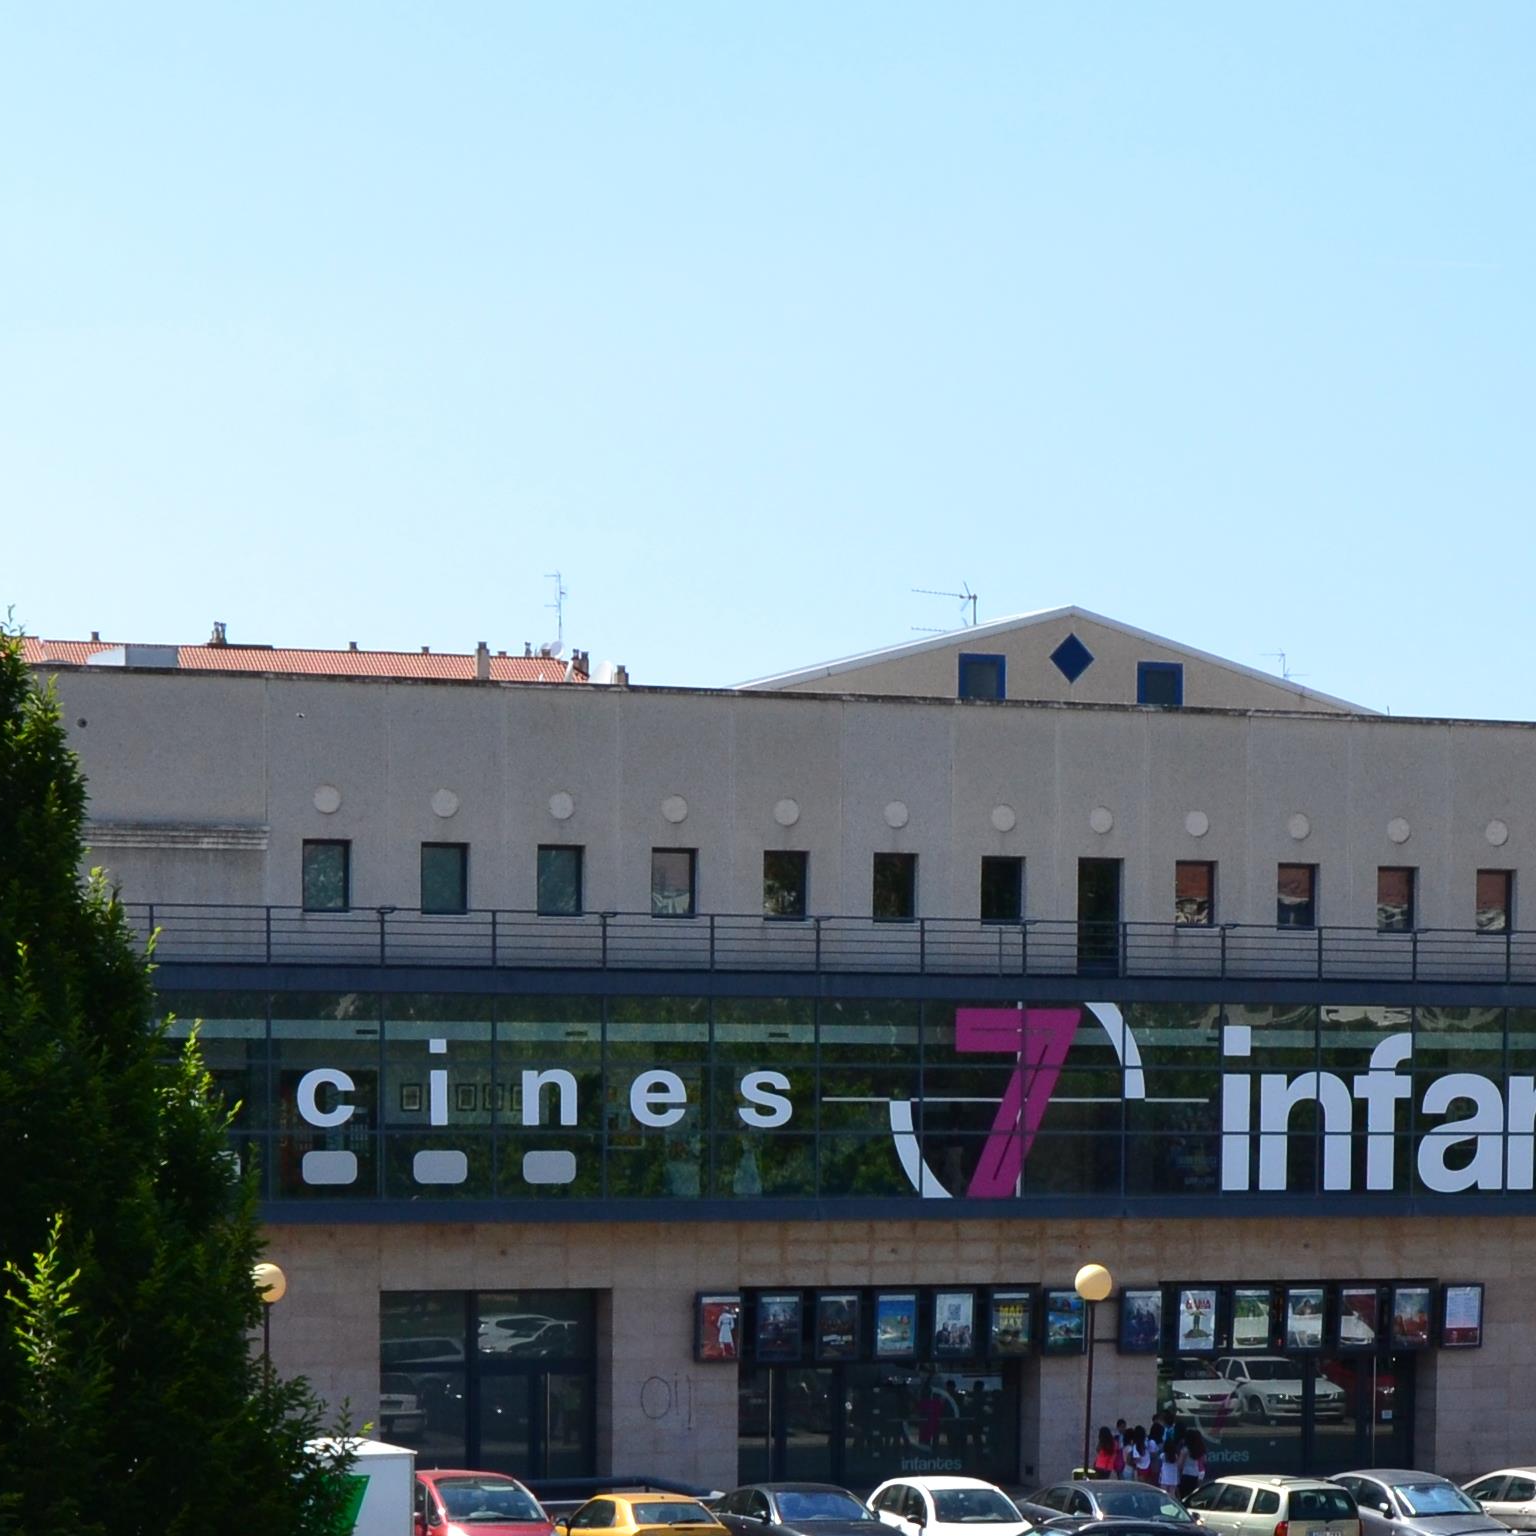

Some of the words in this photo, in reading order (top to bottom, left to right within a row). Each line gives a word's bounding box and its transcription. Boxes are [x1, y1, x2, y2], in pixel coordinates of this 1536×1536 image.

[297, 1038, 793, 1127] cines
[955, 1008, 1082, 1198] 7
[1207, 1449, 1250, 1462] antes
[901, 1456, 962, 1471] infantes
